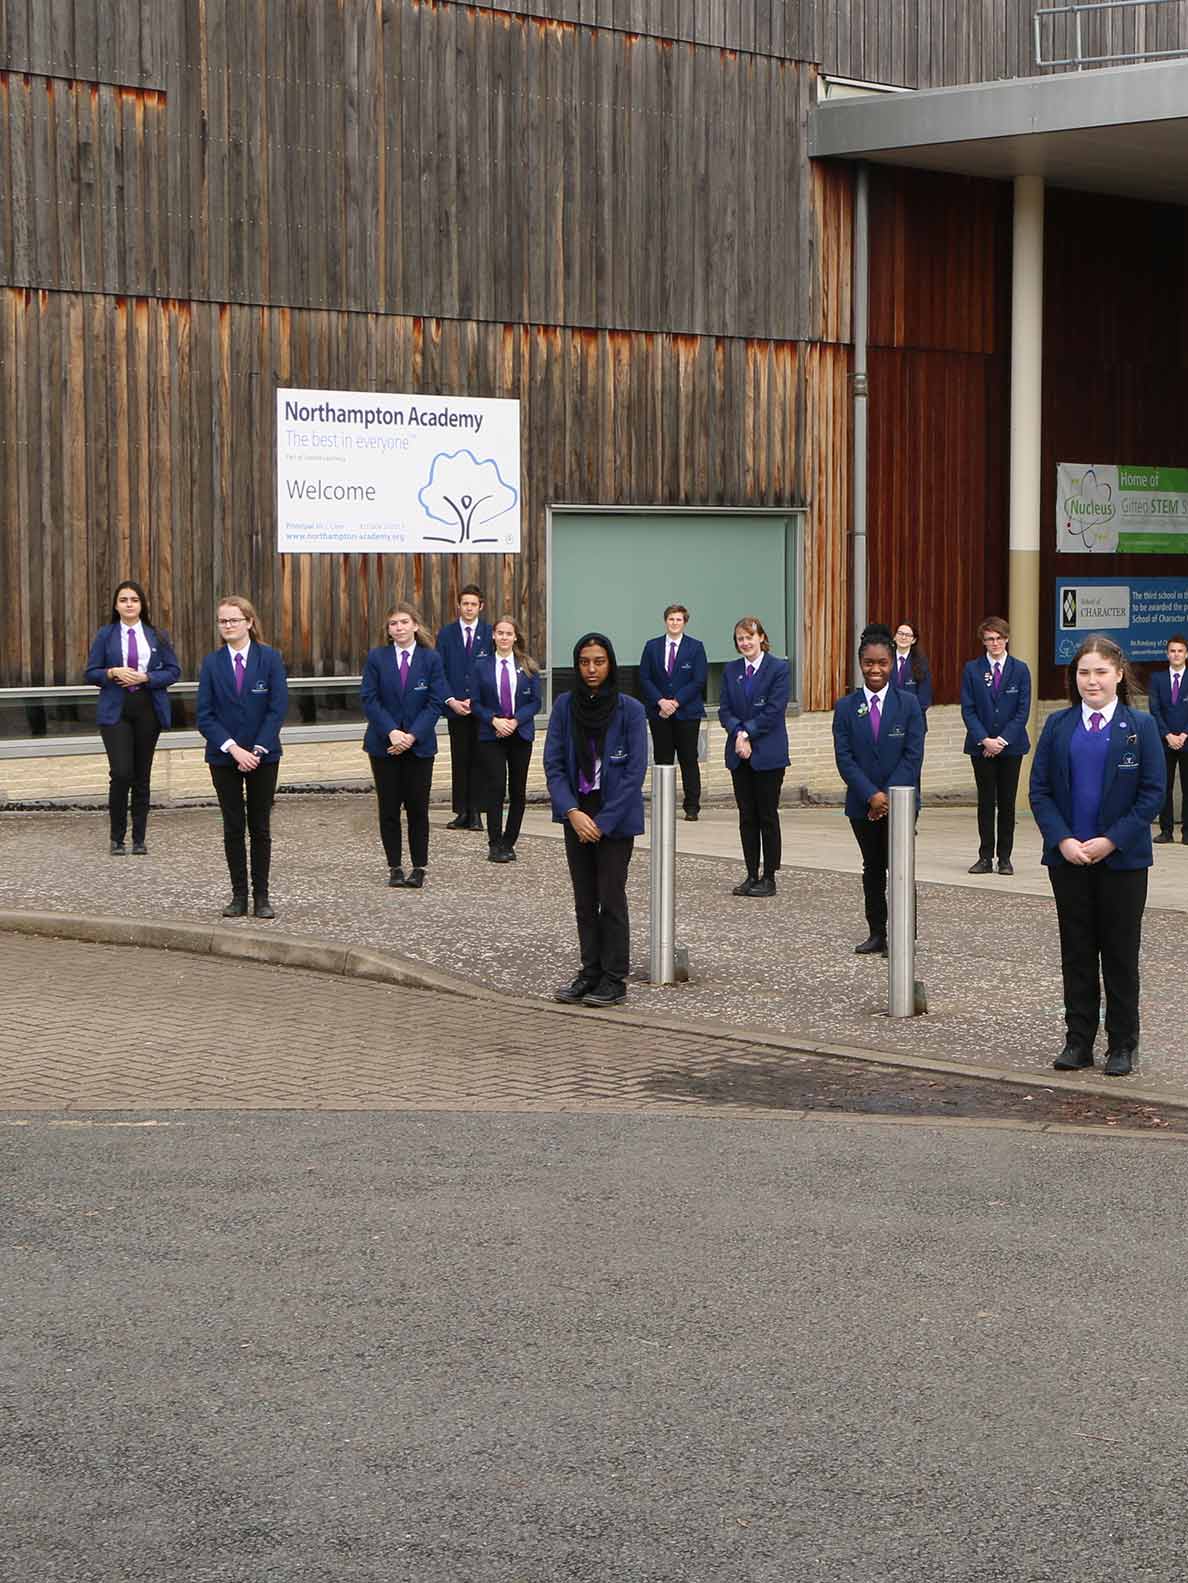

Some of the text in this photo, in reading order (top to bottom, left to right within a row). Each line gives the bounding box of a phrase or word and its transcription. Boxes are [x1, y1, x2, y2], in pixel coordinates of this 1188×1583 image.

[285, 401, 483, 433] Northampton Academy
[286, 430, 409, 454] The best in everyone
[1120, 472, 1160, 487] Home of
[286, 480, 376, 501] Welcome
[1070, 500, 1113, 516] Nucleus
[1152, 499, 1178, 513] STEM
[1132, 591, 1142, 600] The
[1143, 591, 1157, 600] third
[1158, 590, 1177, 600] school
[1080, 607, 1127, 617] CHARACTER
[1140, 603, 1147, 611] be
[1148, 603, 1172, 611] awarded
[1173, 603, 1183, 611] the
[1132, 615, 1151, 624] School
[1159, 615, 1186, 623] Character
